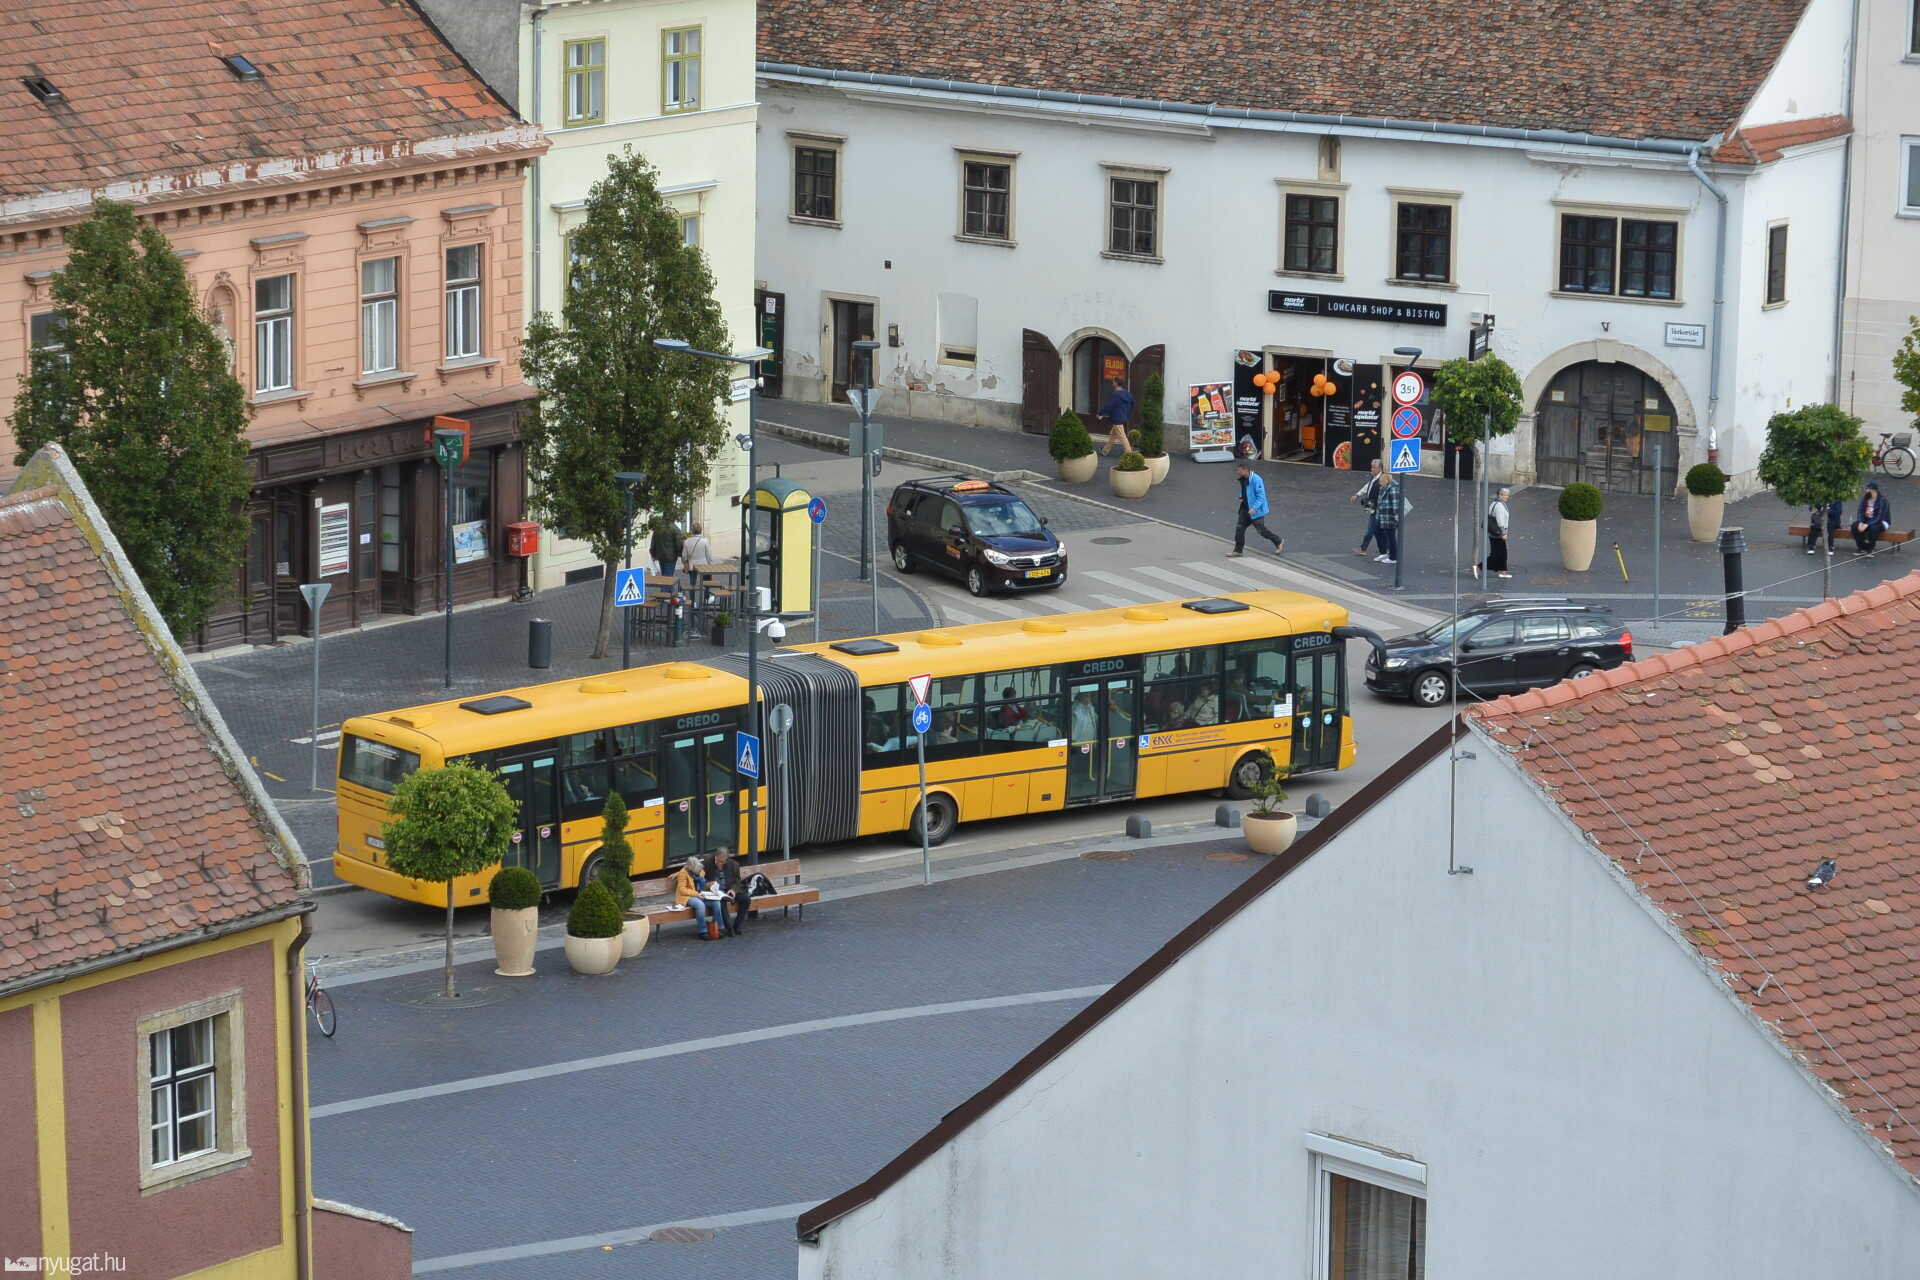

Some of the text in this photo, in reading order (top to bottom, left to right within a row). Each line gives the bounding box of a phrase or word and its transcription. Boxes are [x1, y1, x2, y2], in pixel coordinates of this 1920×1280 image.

[1328, 302, 1367, 313] LOWCARB
[1371, 305, 1393, 316] SHOP
[1406, 309, 1441, 320] BISTRO
[1294, 634, 1332, 649] CREDO
[1083, 659, 1124, 673] CREDO
[677, 713, 720, 729] CREDO
